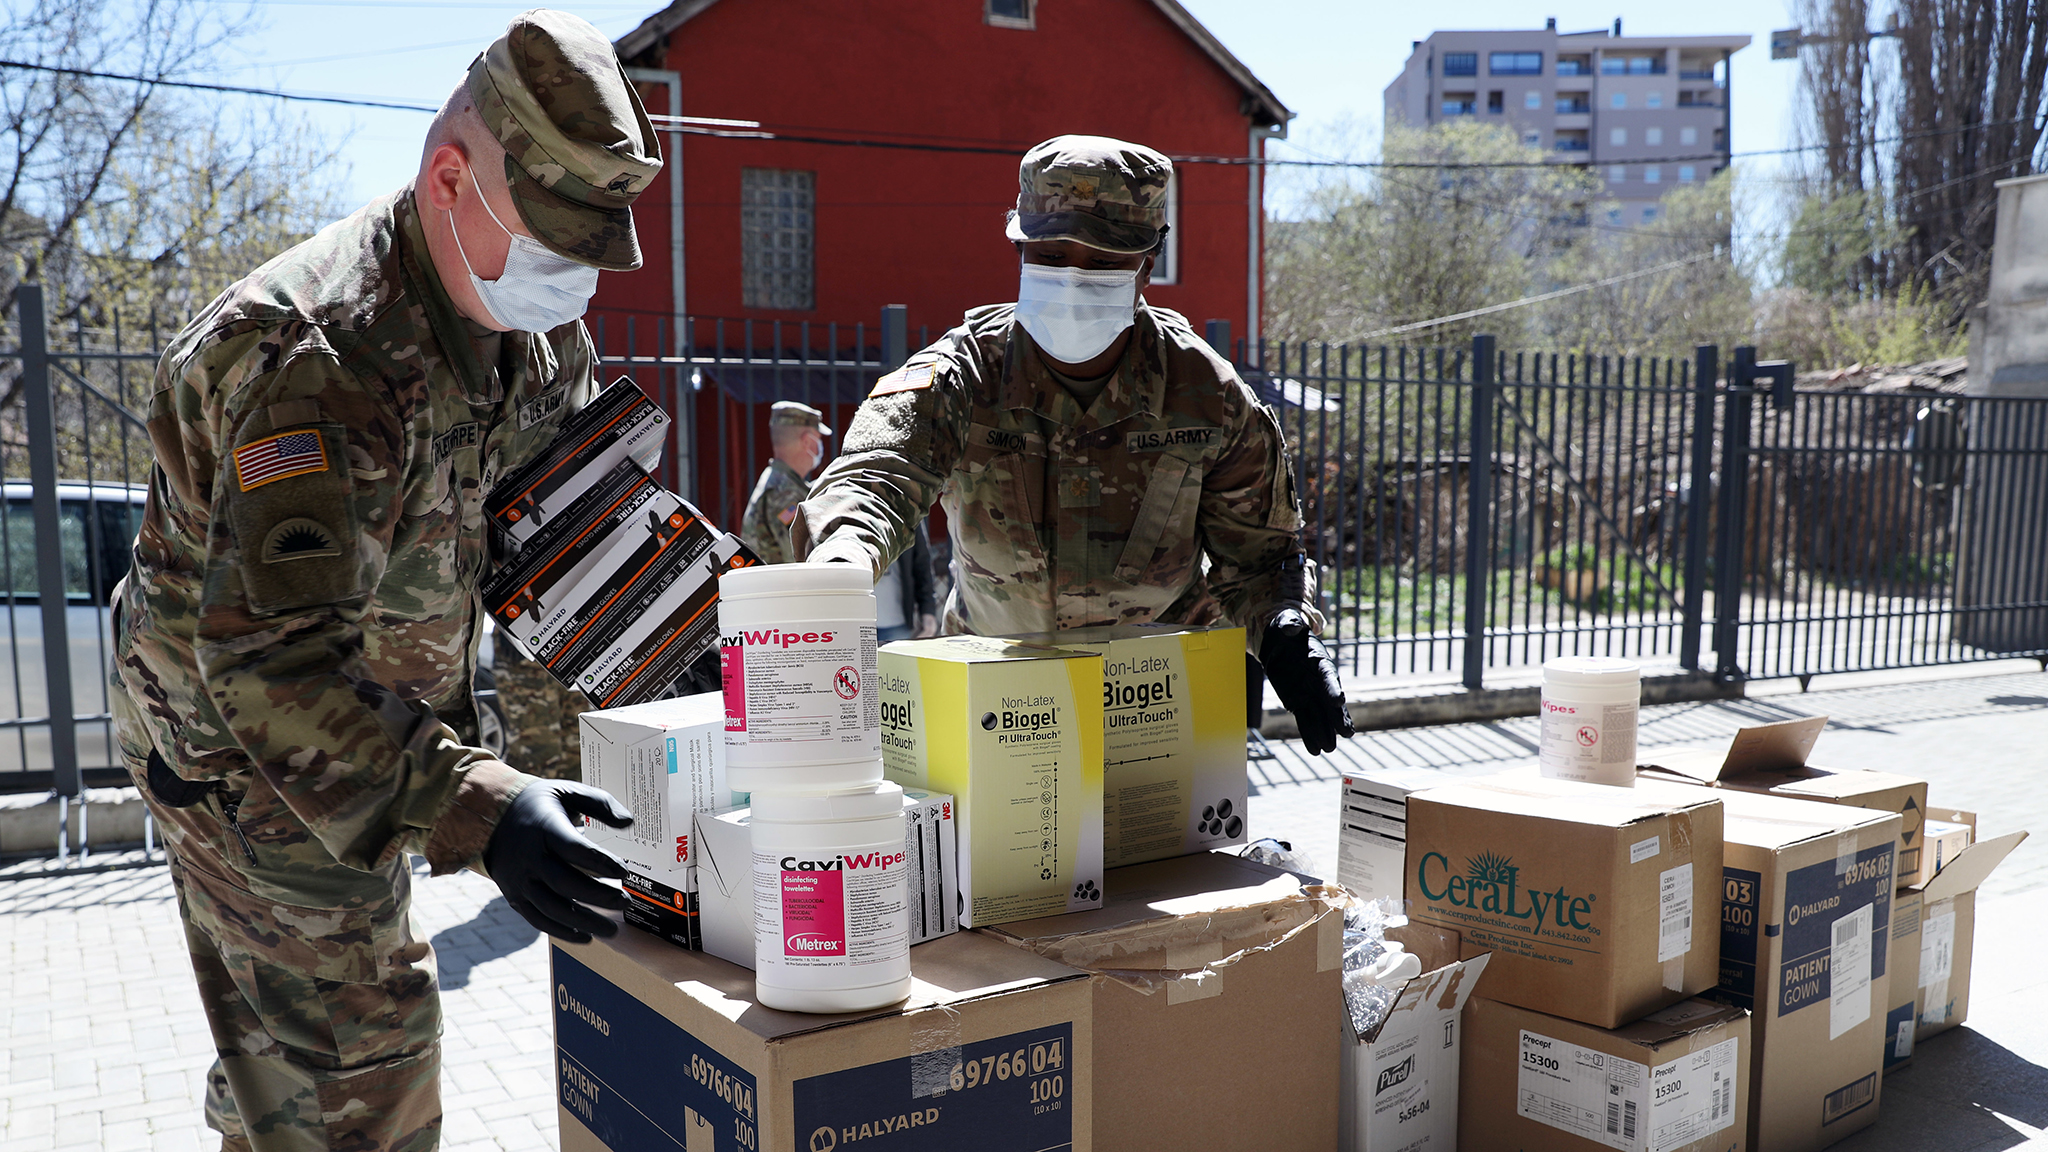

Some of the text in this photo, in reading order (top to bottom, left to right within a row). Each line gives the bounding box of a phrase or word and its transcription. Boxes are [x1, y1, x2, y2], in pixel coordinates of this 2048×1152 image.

[615, 404, 653, 436] BLACK-FIRE
[626, 422, 655, 446] HALYARD
[986, 430, 1026, 450] SIMON
[1137, 430, 1212, 449] U.S.ARMY
[616, 485, 656, 521] BLACK-FIRE
[599, 588, 617, 607] GLOVES
[538, 608, 567, 637] HALYARD
[540, 618, 578, 657] BLACK-FIRE
[656, 627, 675, 646] GLOVES
[720, 629, 833, 648] aviWipes
[593, 647, 622, 676] HALYARD
[594, 656, 635, 696] BLACK-FIRE
[879, 673, 910, 694] n-Latex
[1002, 695, 1055, 709] Non-Latex
[1103, 675, 1173, 709] Biogel
[725, 715, 742, 727] etrex
[881, 700, 912, 730] ogel
[1002, 707, 1057, 730] Biogel
[1109, 708, 1173, 728] UltraTouch
[881, 731, 913, 750] traTouch
[999, 731, 1057, 743] PI UltraTouch
[1343, 777, 1352, 785] 3M
[943, 802, 950, 820] 3M
[676, 835, 688, 863] 3M
[780, 850, 905, 871] CaviWipes
[1845, 854, 1890, 886] 69766 03
[784, 876, 818, 884] disinfecting
[1875, 877, 1889, 897] 100
[1418, 852, 1591, 935] CeraLyte
[1725, 880, 1751, 903] 03
[1722, 905, 1752, 927] 100
[1801, 895, 1840, 918] HALYARD
[1427, 904, 1531, 933] www.ceraproductsinc.com
[1470, 930, 1534, 950] Cera Products Inc.
[1541, 928, 1591, 944] 843.842.2600
[1725, 924, 1734, 933] (10
[1740, 927, 1750, 936] 10)
[796, 938, 838, 950] Metrex
[1477, 940, 1489, 948] Suite
[1502, 946, 1517, 954] Hilton
[1519, 949, 1531, 957] Head
[1720, 967, 1742, 978] versal
[1785, 954, 1831, 986] PATIENT
[1784, 979, 1820, 1006] GOWN
[569, 996, 610, 1036] HALYARD
[1522, 1034, 1551, 1049] Precept
[950, 1041, 1062, 1091] 69766 04
[1522, 1051, 1559, 1071] 15300
[1654, 1064, 1677, 1079] Precept
[562, 1058, 600, 1104] PATIENT
[1380, 1062, 1409, 1088] Purell
[691, 1053, 753, 1119] 69766 04
[1030, 1075, 1064, 1104] 100
[1655, 1079, 1682, 1099] 15300
[563, 1082, 593, 1122] GOWN
[1034, 1105, 1045, 1116] (10
[1050, 1101, 1061, 1111] 10)
[1585, 1111, 1594, 1119] 500
[734, 1117, 755, 1151] 100
[842, 1108, 940, 1144] HALYARD
